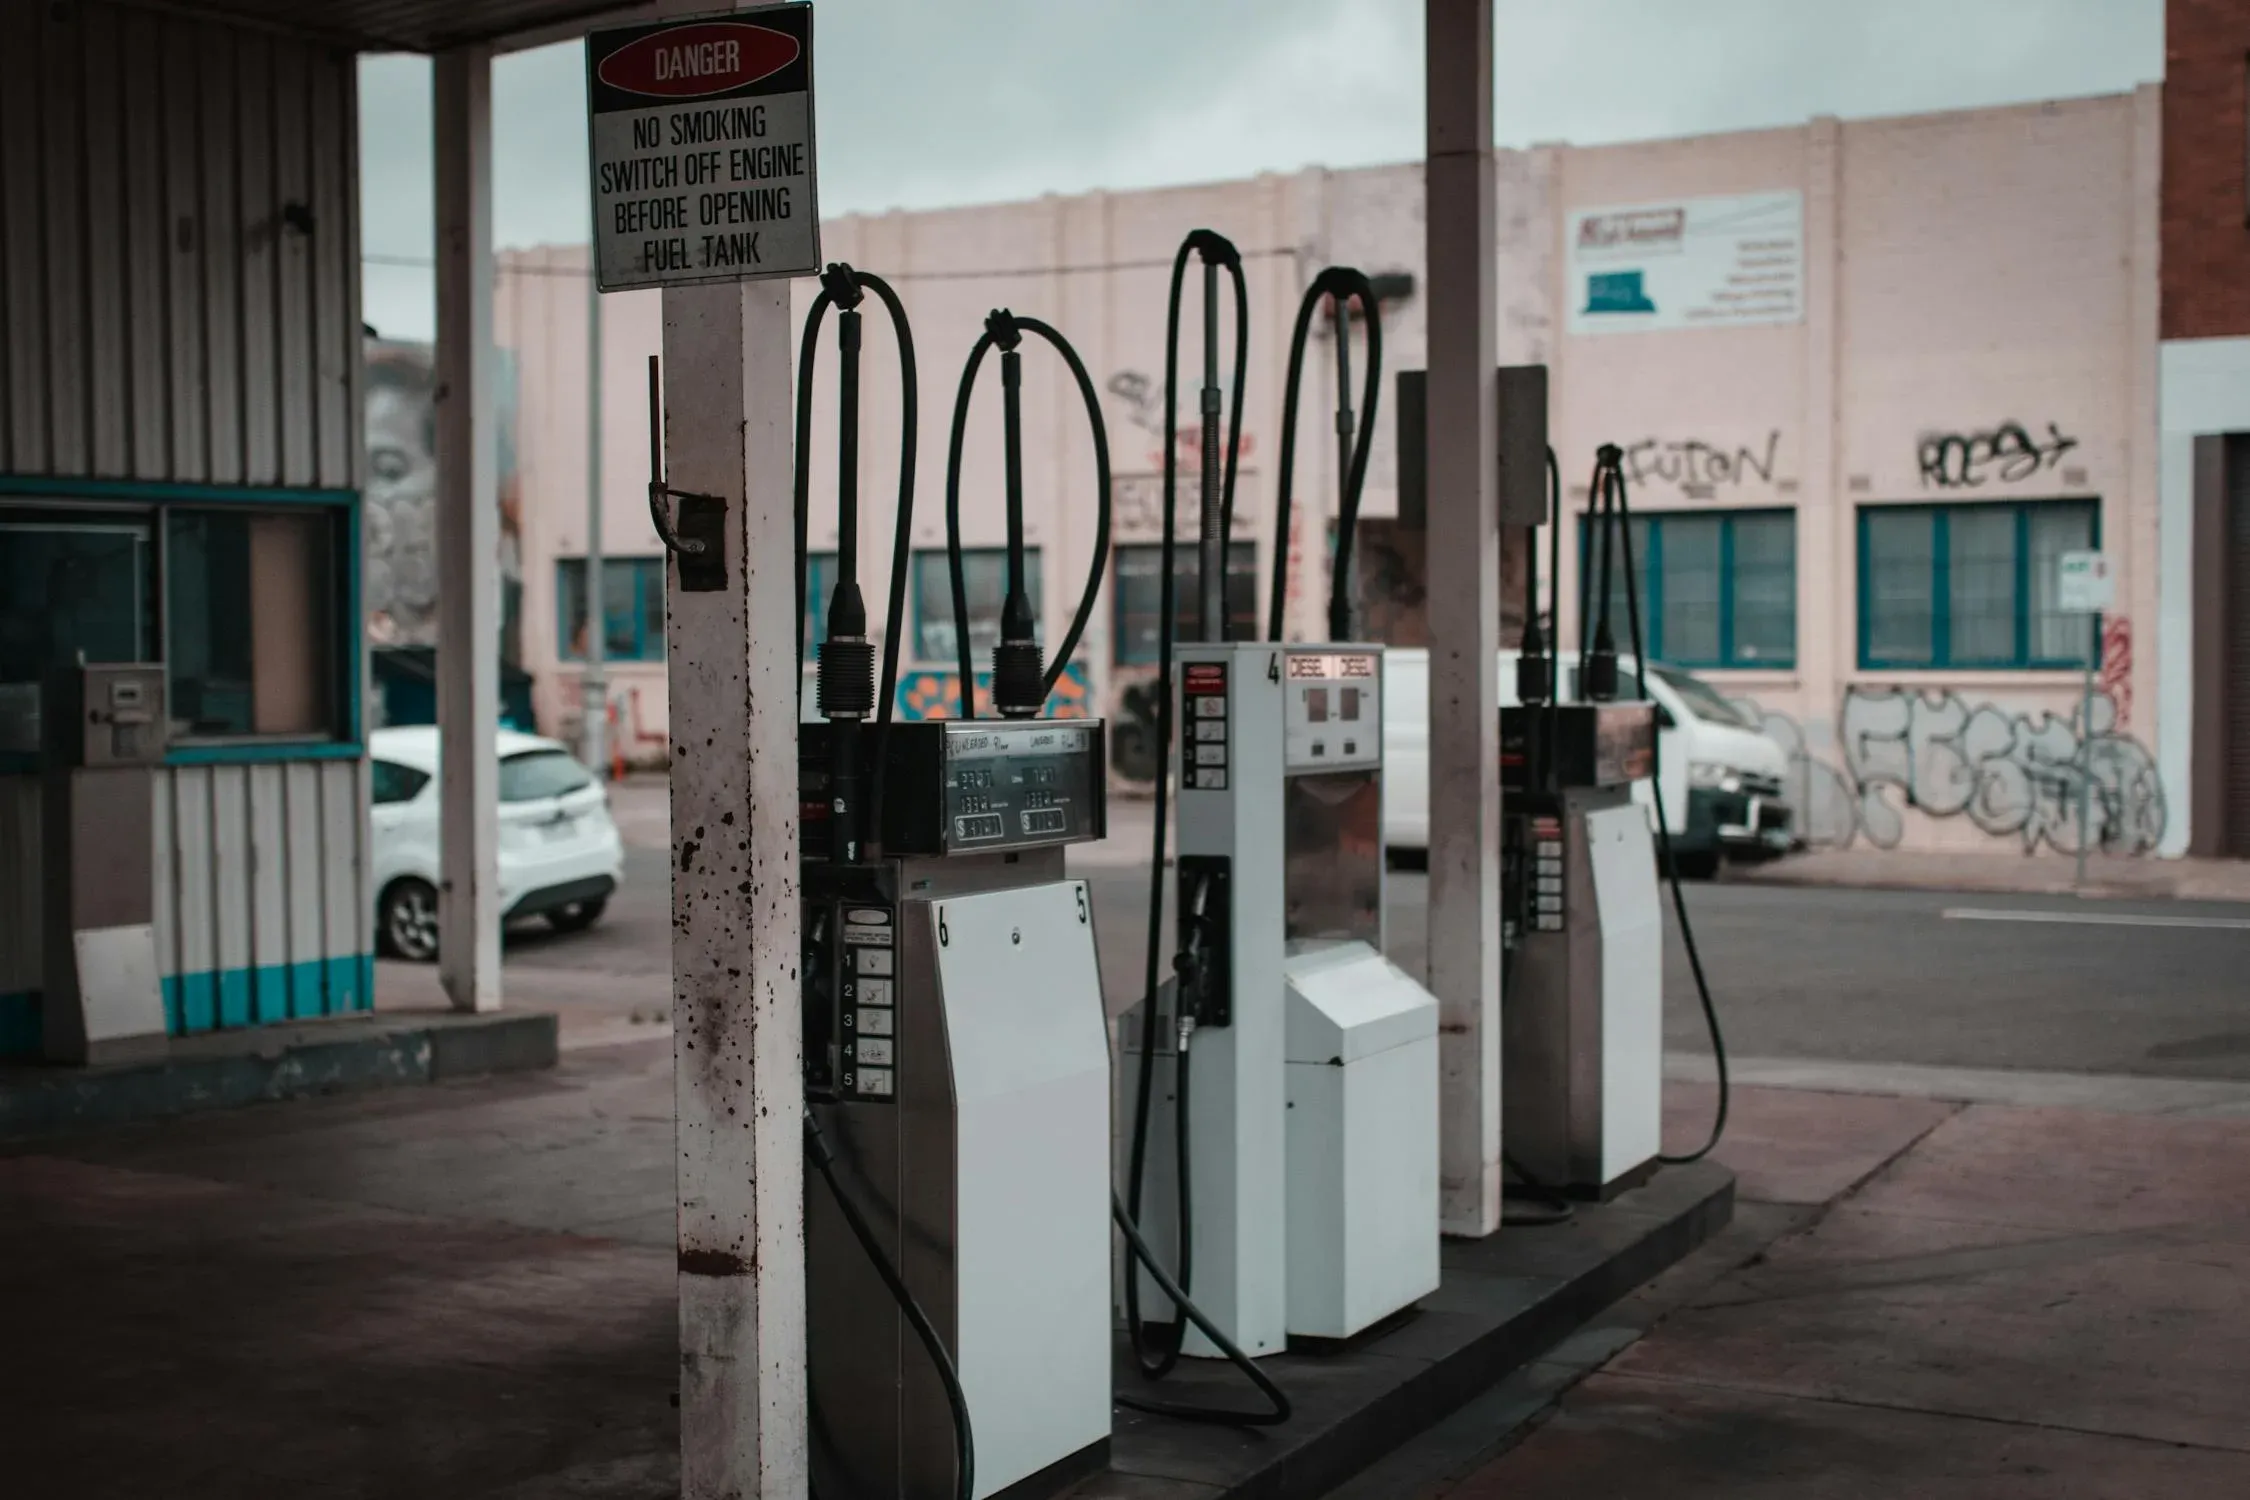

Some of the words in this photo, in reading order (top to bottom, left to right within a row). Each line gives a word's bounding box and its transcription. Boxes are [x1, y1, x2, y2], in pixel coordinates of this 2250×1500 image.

[655, 40, 740, 80] DANGER
[633, 116, 660, 150] NO
[670, 105, 766, 145] SMOKING
[600, 155, 678, 194] SWITCH
[684, 151, 721, 185] OFF
[730, 143, 804, 182] ENGINE
[615, 196, 687, 234] BEFORE
[699, 187, 791, 225] OPENING
[644, 238, 692, 273] FUEL
[702, 232, 761, 268] TANK
[1267, 652, 1280, 686] 4
[1075, 885, 1087, 925] 5
[938, 906, 949, 948] 6
[844, 953, 852, 968] 1
[843, 984, 854, 998] 2
[843, 1014, 854, 1028] 3
[843, 1043, 854, 1057] 4
[843, 1072, 854, 1087] 5
